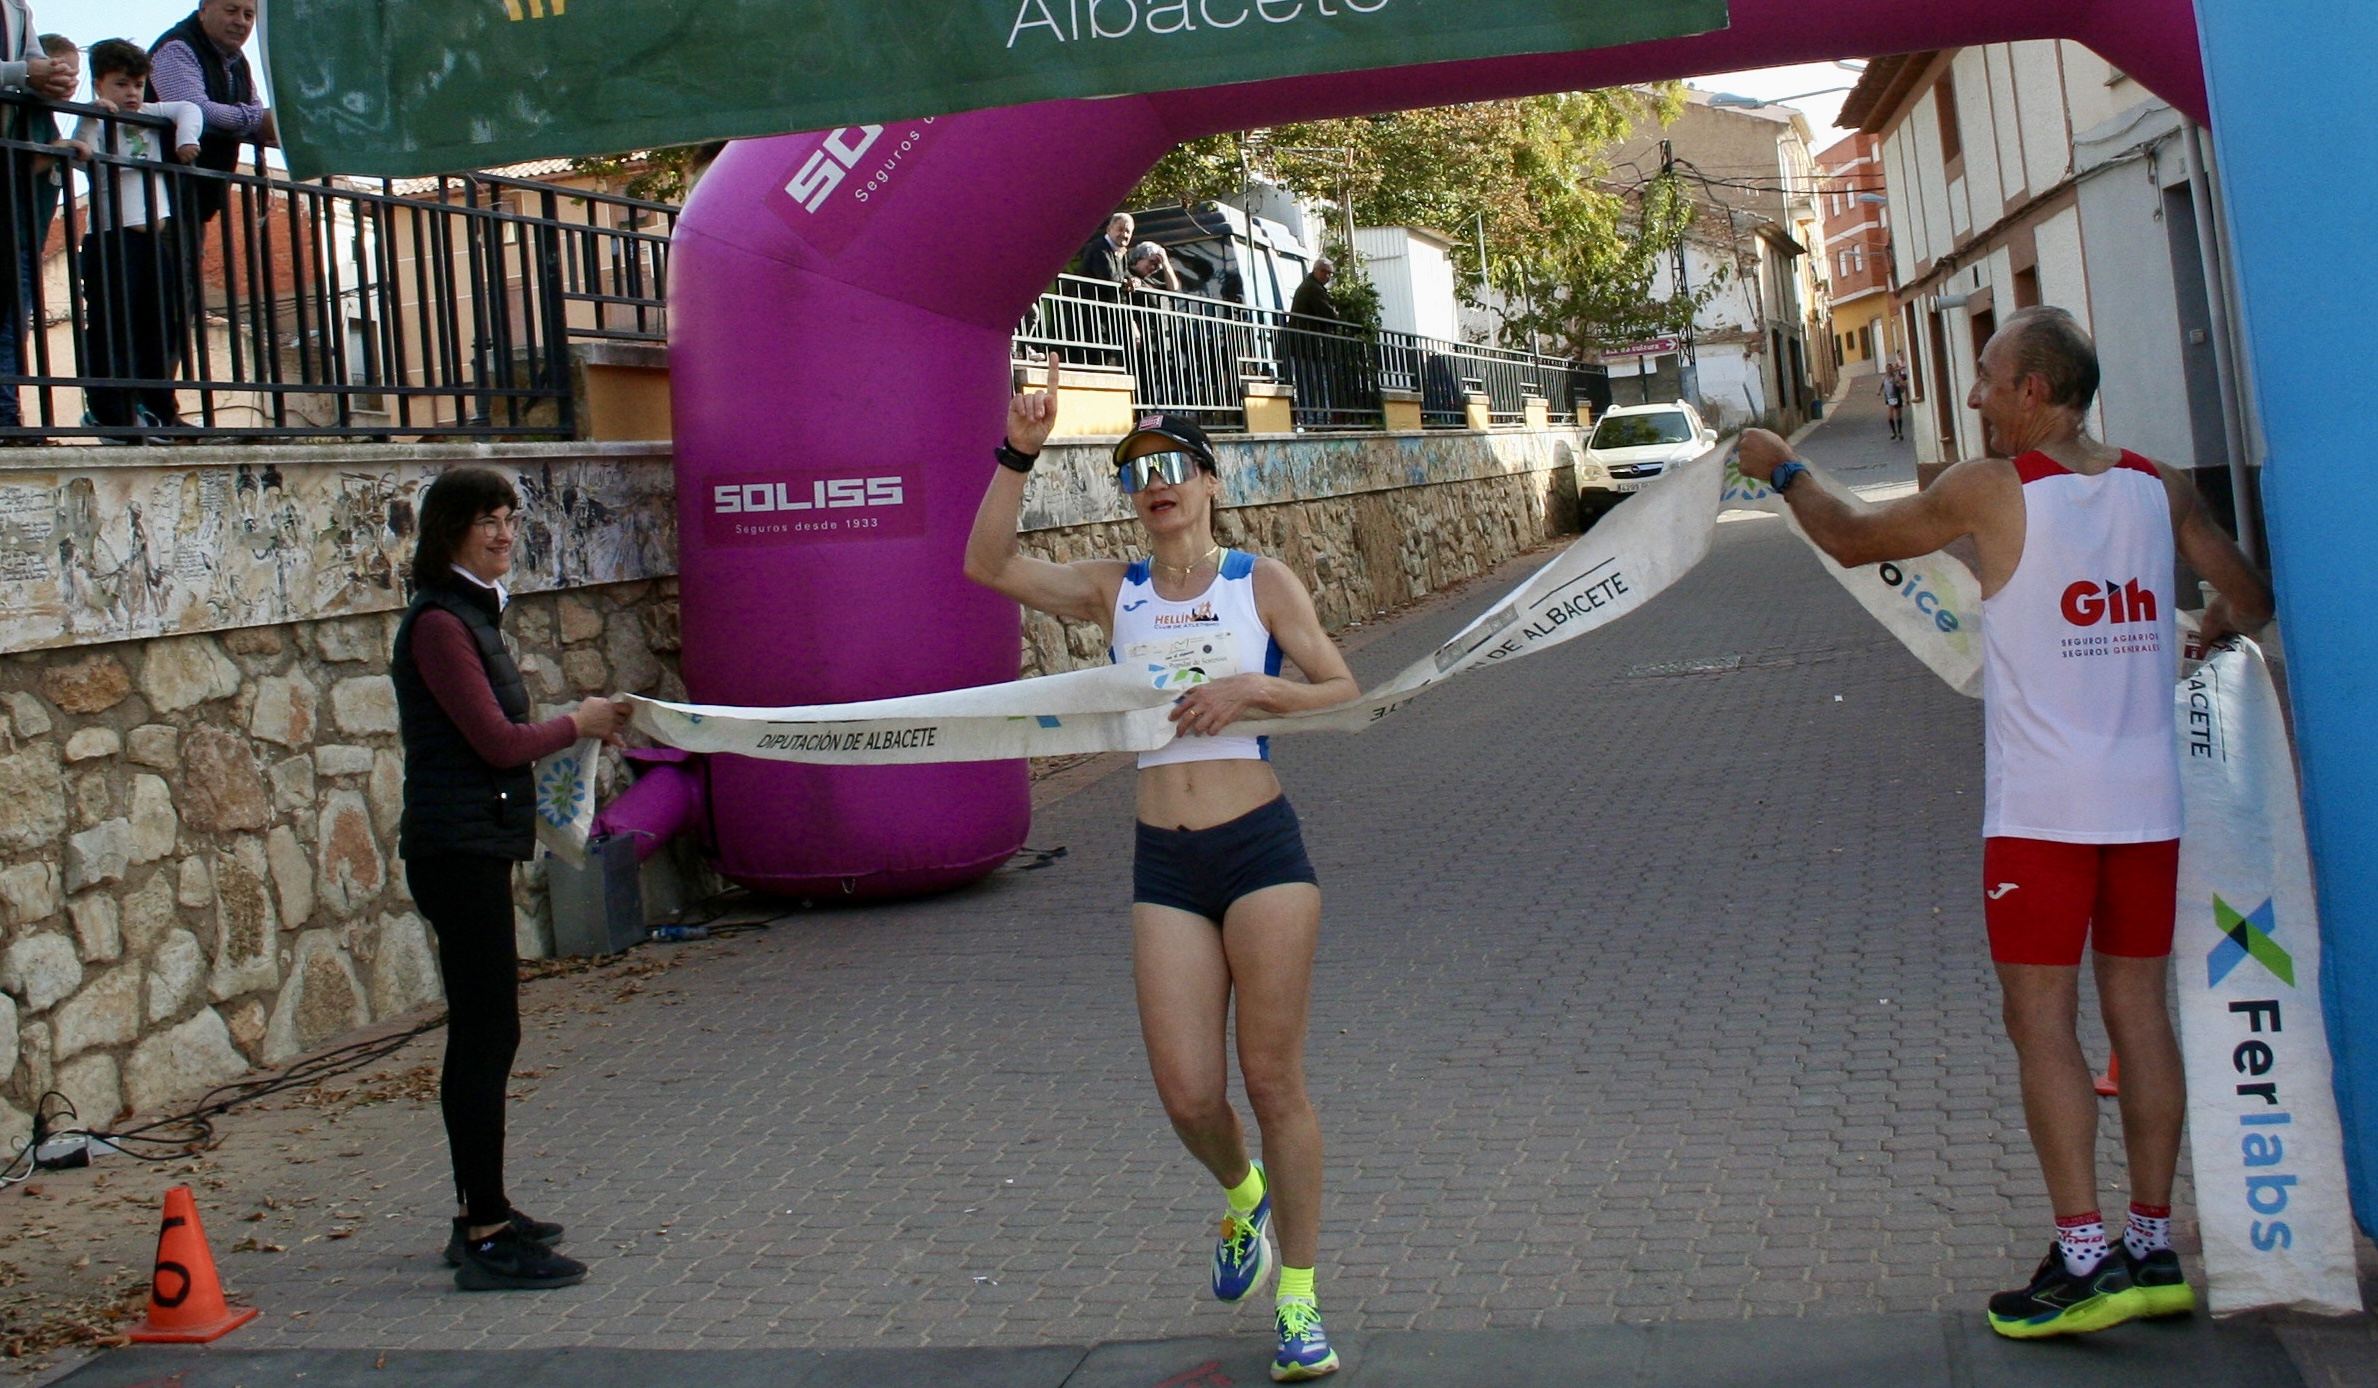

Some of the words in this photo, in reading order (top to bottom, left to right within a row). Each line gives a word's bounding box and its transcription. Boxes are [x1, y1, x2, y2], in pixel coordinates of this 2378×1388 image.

[854, 130, 920, 202] Seguros
[714, 476, 903, 513] SOLISS
[735, 523, 788, 535] Seguros
[795, 521, 837, 532] desde
[846, 518, 878, 529] 1933
[1487, 639, 1523, 659] DE
[1522, 572, 1629, 641] ALBACETE
[1879, 562, 1959, 633] oice
[2061, 636, 2108, 647] SEGUROS
[2112, 632, 2159, 644] AGRARIOS
[2062, 648, 2109, 658] SEGUROS
[2113, 644, 2160, 654] GENERALES
[756, 730, 843, 750] DIPUTACIÓN
[842, 732, 864, 751] DE
[863, 727, 938, 750] ALBACETE
[2187, 670, 2212, 759] ACETE
[2227, 999, 2298, 1253] Ferlabs
